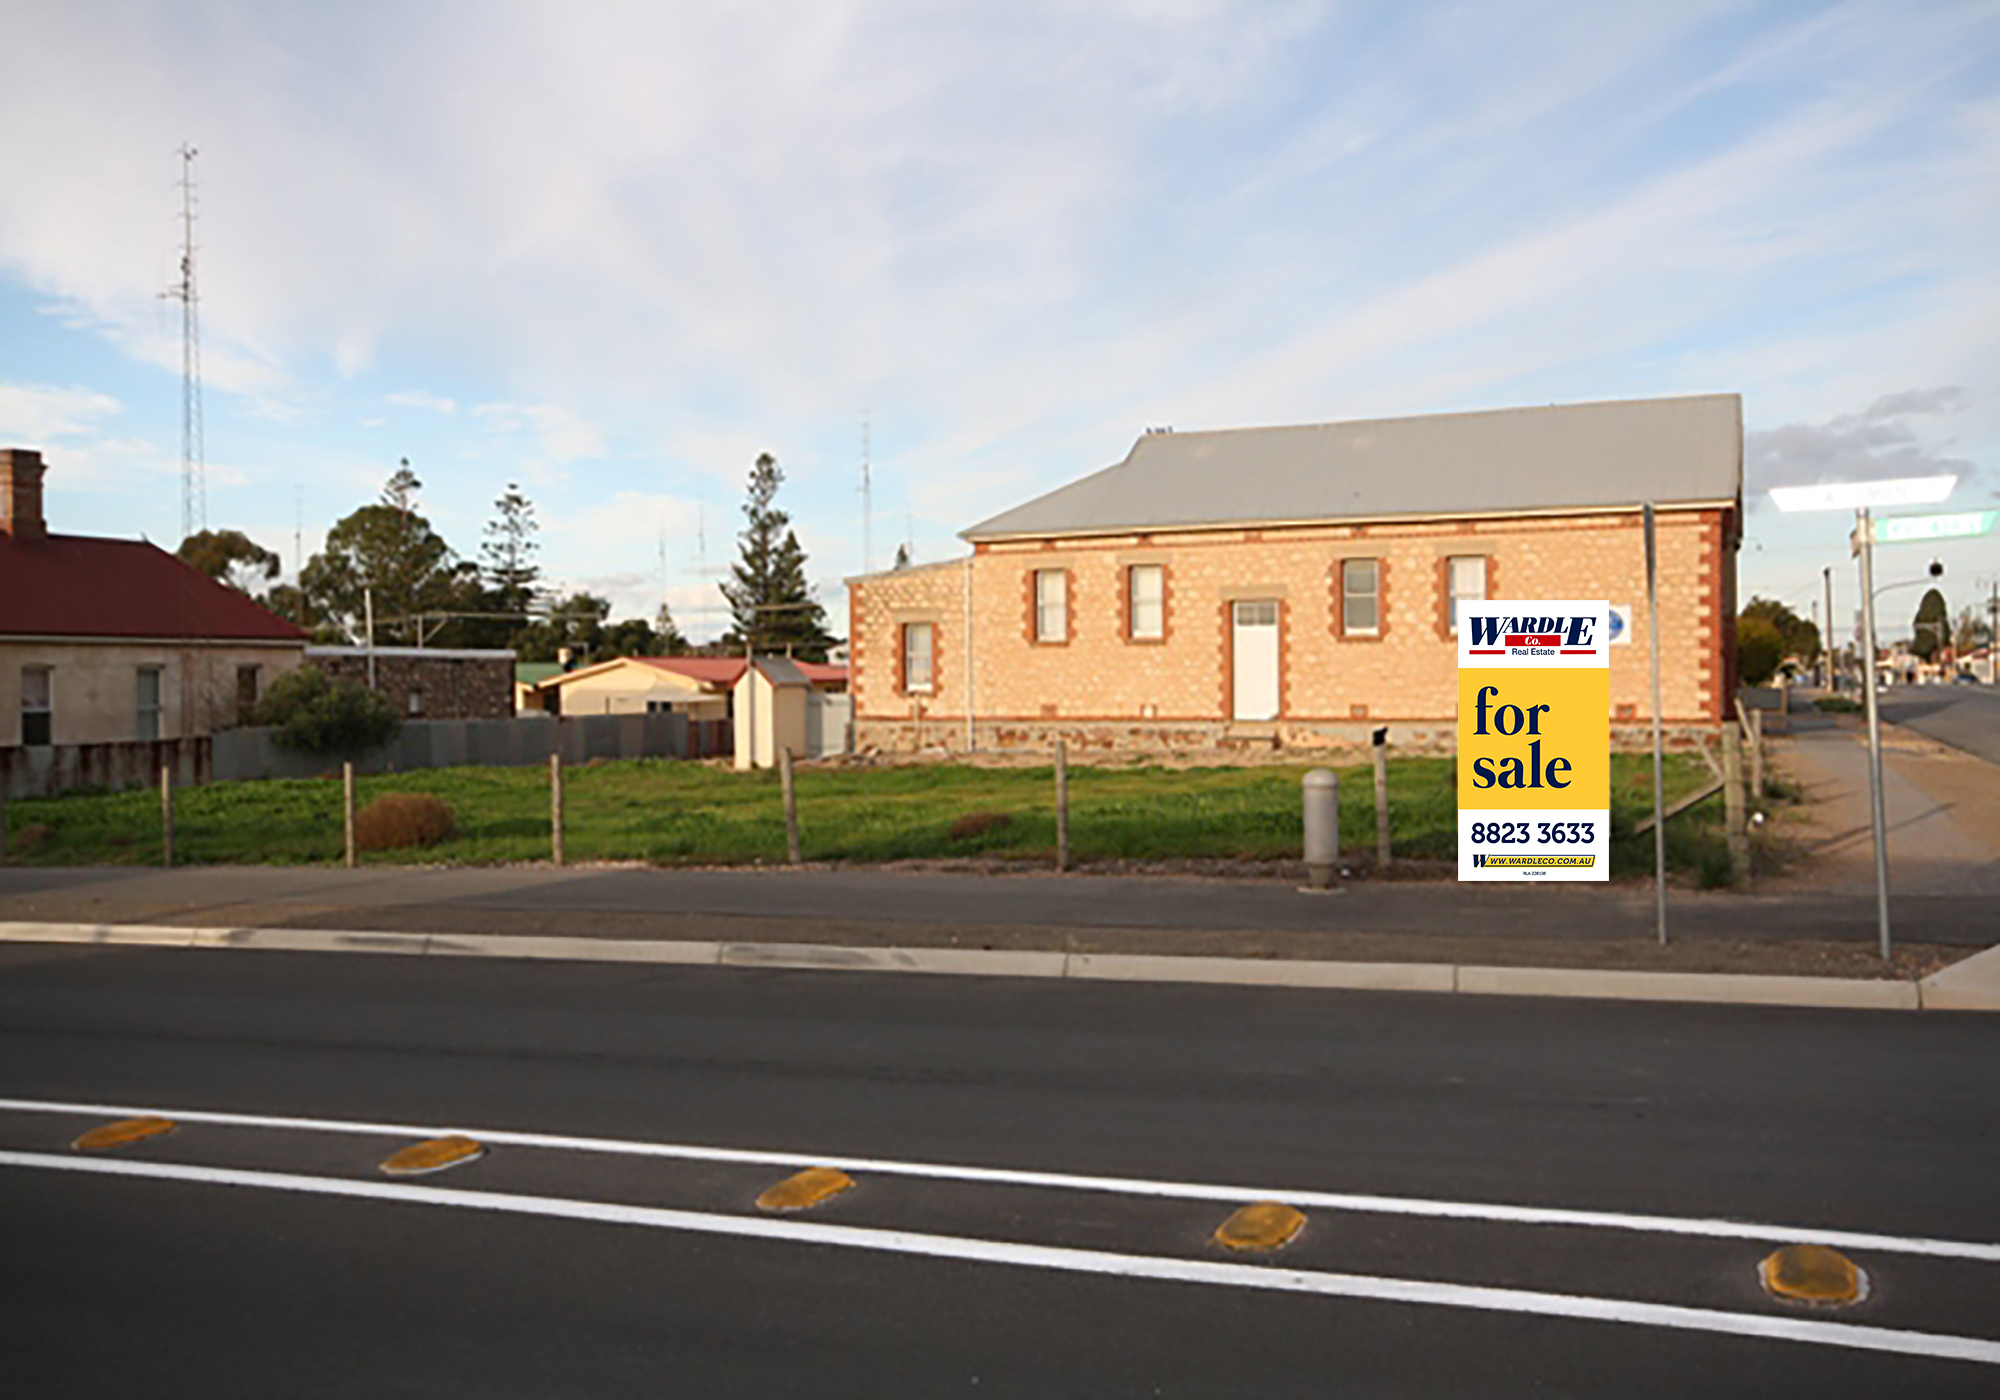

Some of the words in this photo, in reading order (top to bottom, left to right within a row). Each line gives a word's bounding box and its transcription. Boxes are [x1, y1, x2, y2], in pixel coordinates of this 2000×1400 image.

[1469, 617, 1597, 646] WARDLE
[1524, 636, 1541, 646] Co.
[1512, 648, 1529, 656] Real
[1531, 648, 1555, 656] Estate
[1473, 686, 1550, 736] for
[1472, 739, 1572, 789] sale
[1471, 822, 1530, 844] 8823
[1537, 822, 1595, 844] 3633
